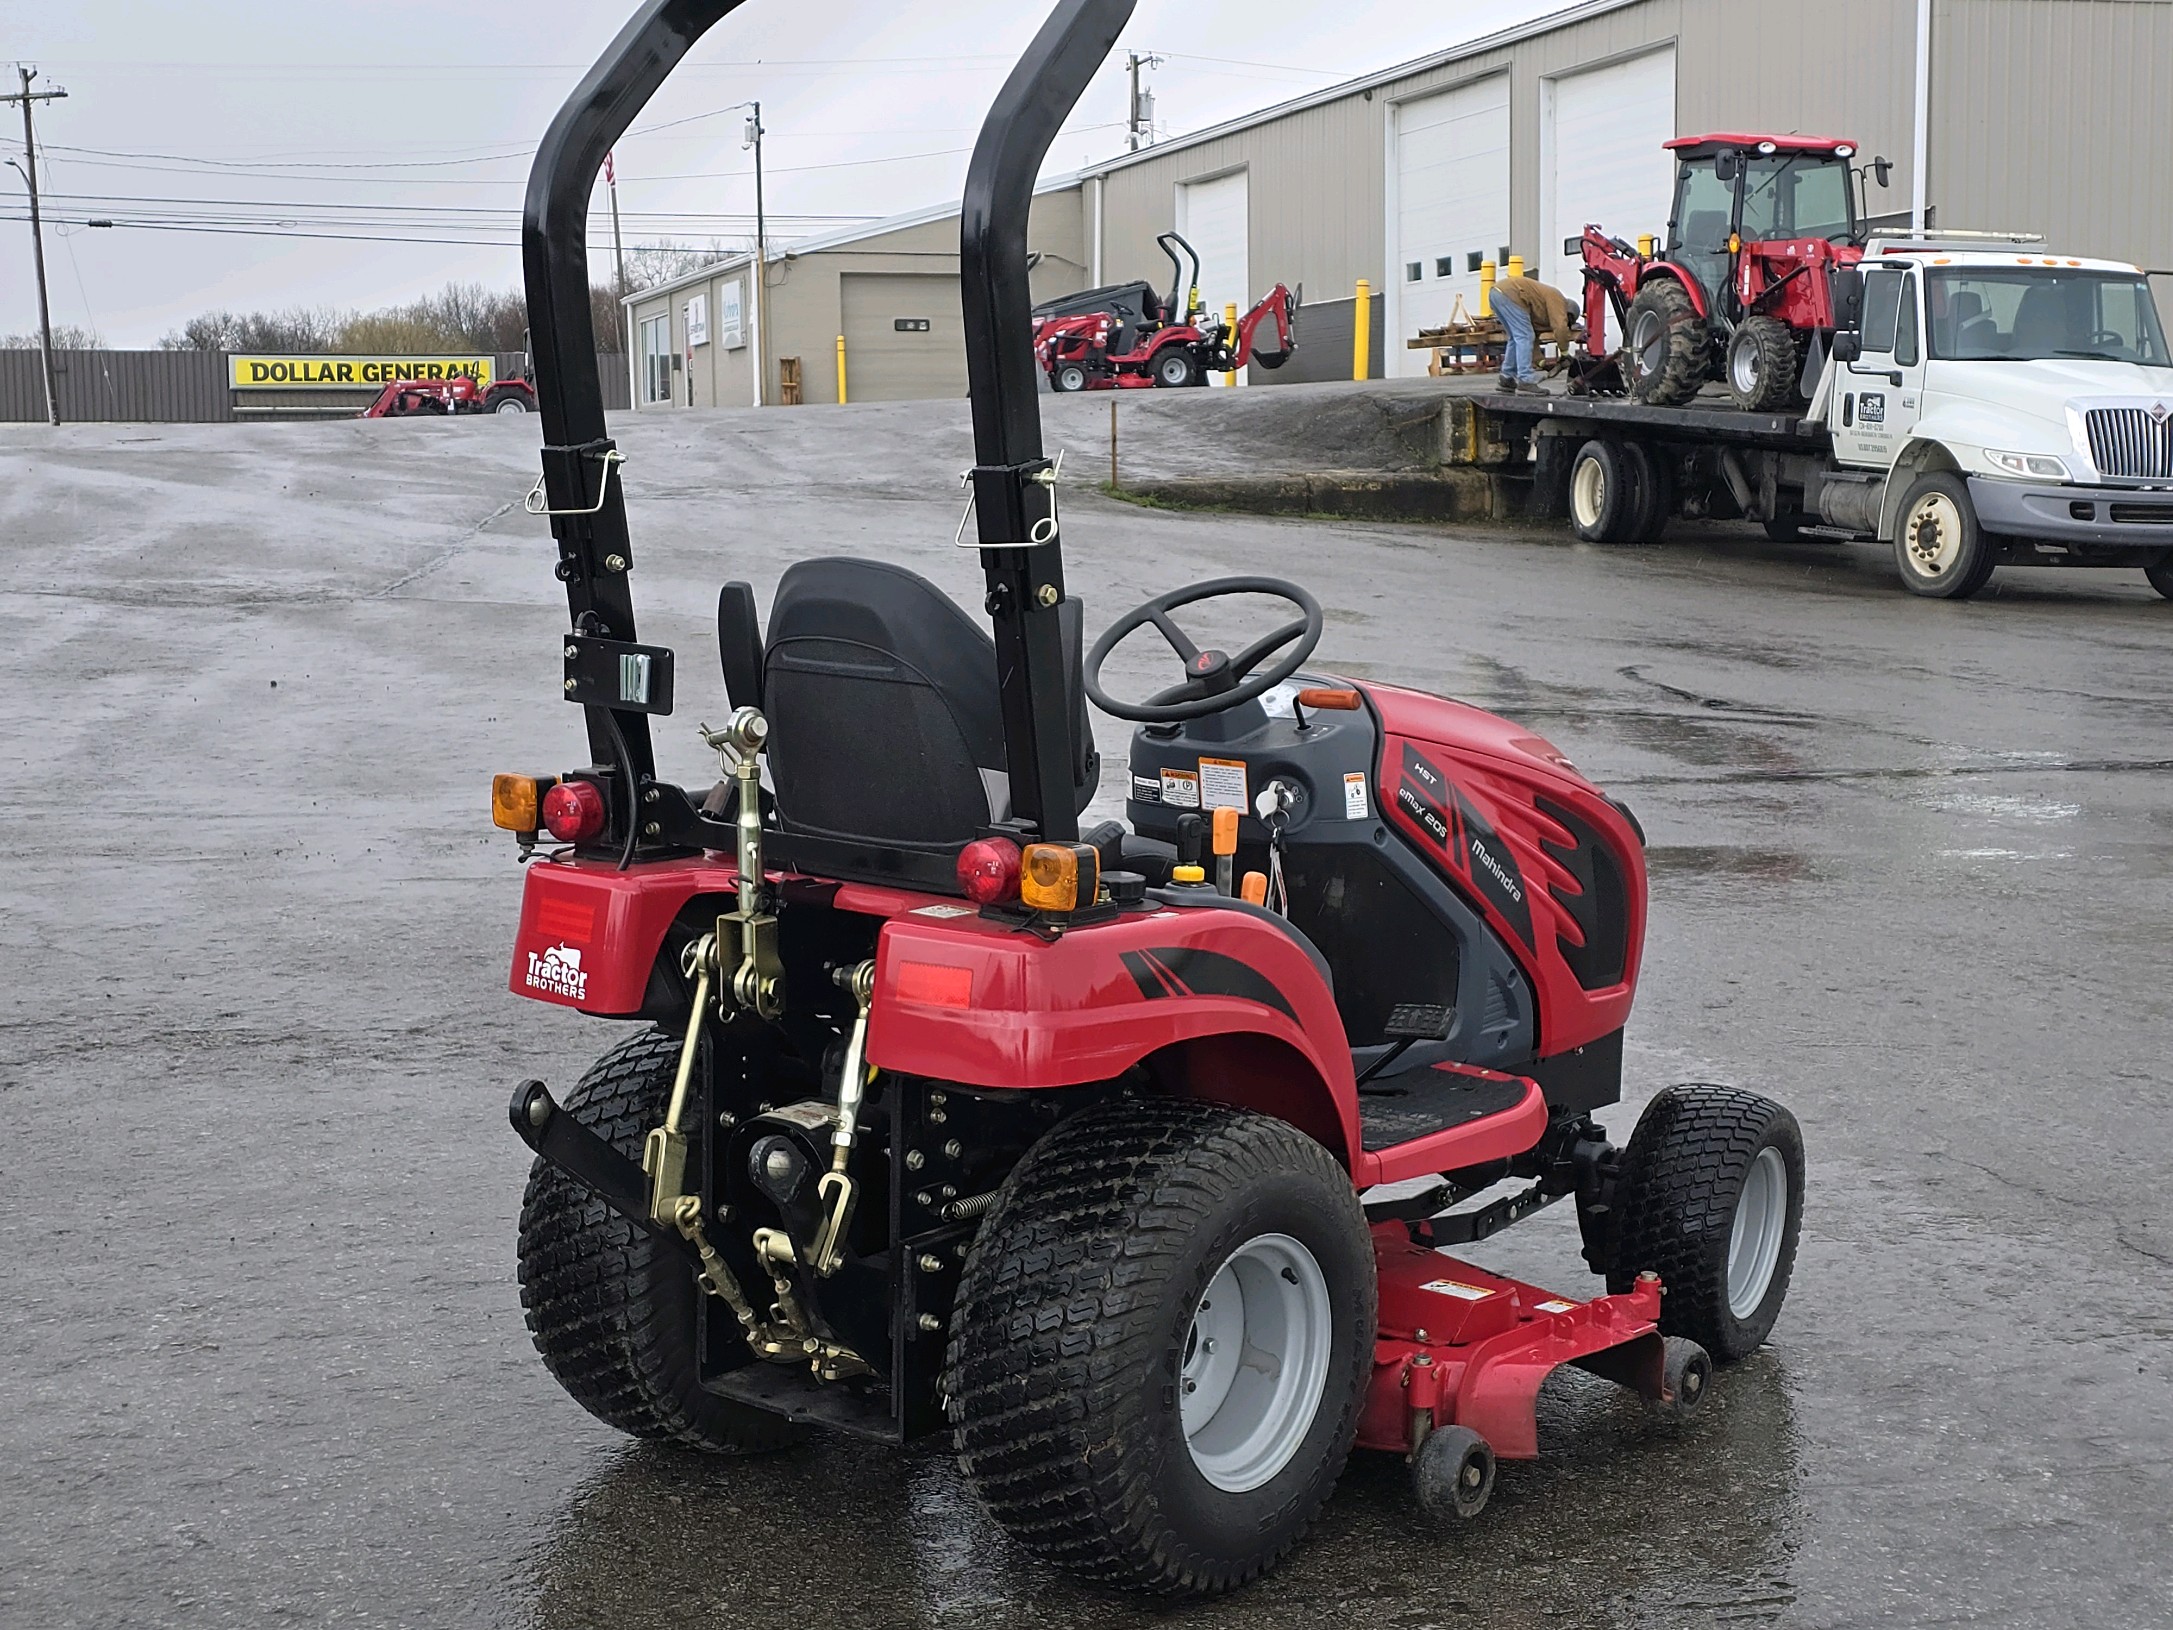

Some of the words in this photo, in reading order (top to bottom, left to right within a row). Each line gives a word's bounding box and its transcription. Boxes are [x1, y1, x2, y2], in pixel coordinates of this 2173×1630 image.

[250, 363, 354, 382] DOLLAR
[1860, 402, 1884, 415] Tractor
[1414, 762, 1438, 785] HST
[1399, 788, 1426, 816] eMax
[1424, 812, 1448, 838] 20S
[1472, 839, 1522, 903] Mahindra
[528, 951, 588, 988] Tractor
[526, 973, 586, 1000] BROTHERS
[1160, 1197, 1260, 1414] CARLISLE
